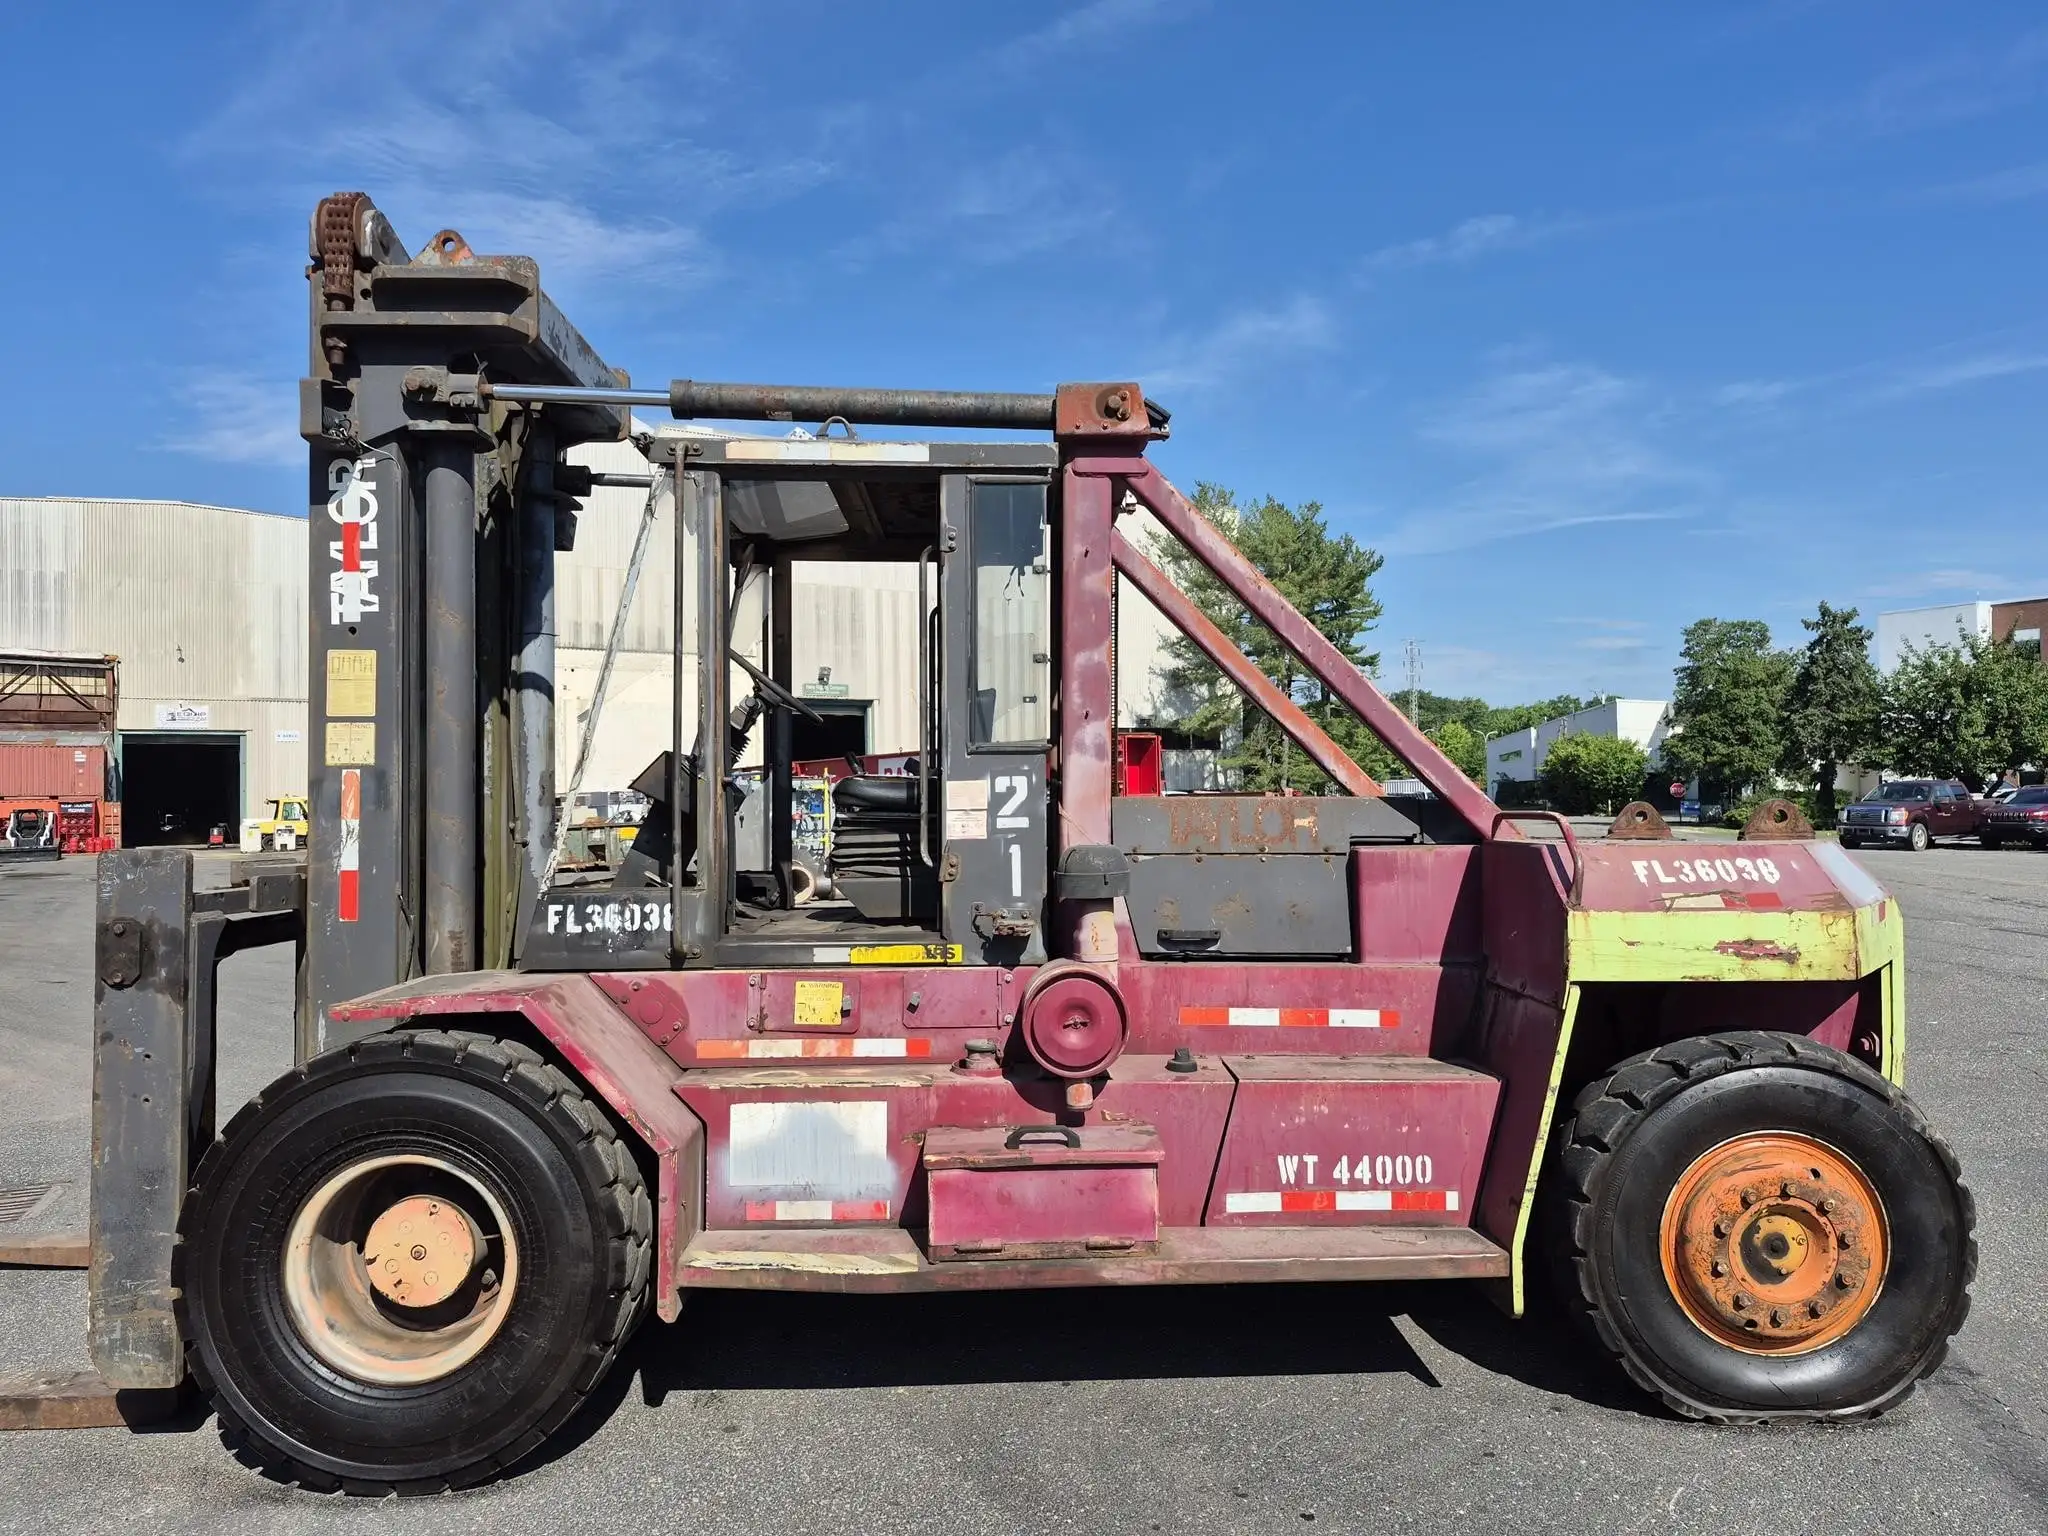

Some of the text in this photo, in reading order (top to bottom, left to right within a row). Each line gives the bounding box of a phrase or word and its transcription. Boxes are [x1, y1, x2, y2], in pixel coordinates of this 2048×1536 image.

[327, 457, 380, 625] TAYLOR
[994, 775, 1029, 829] 2
[1166, 798, 1319, 846] TAYLOR
[1008, 844, 1022, 897] 1
[1631, 857, 1781, 888] FL36038
[1277, 1154, 1433, 1185] WT 44000
